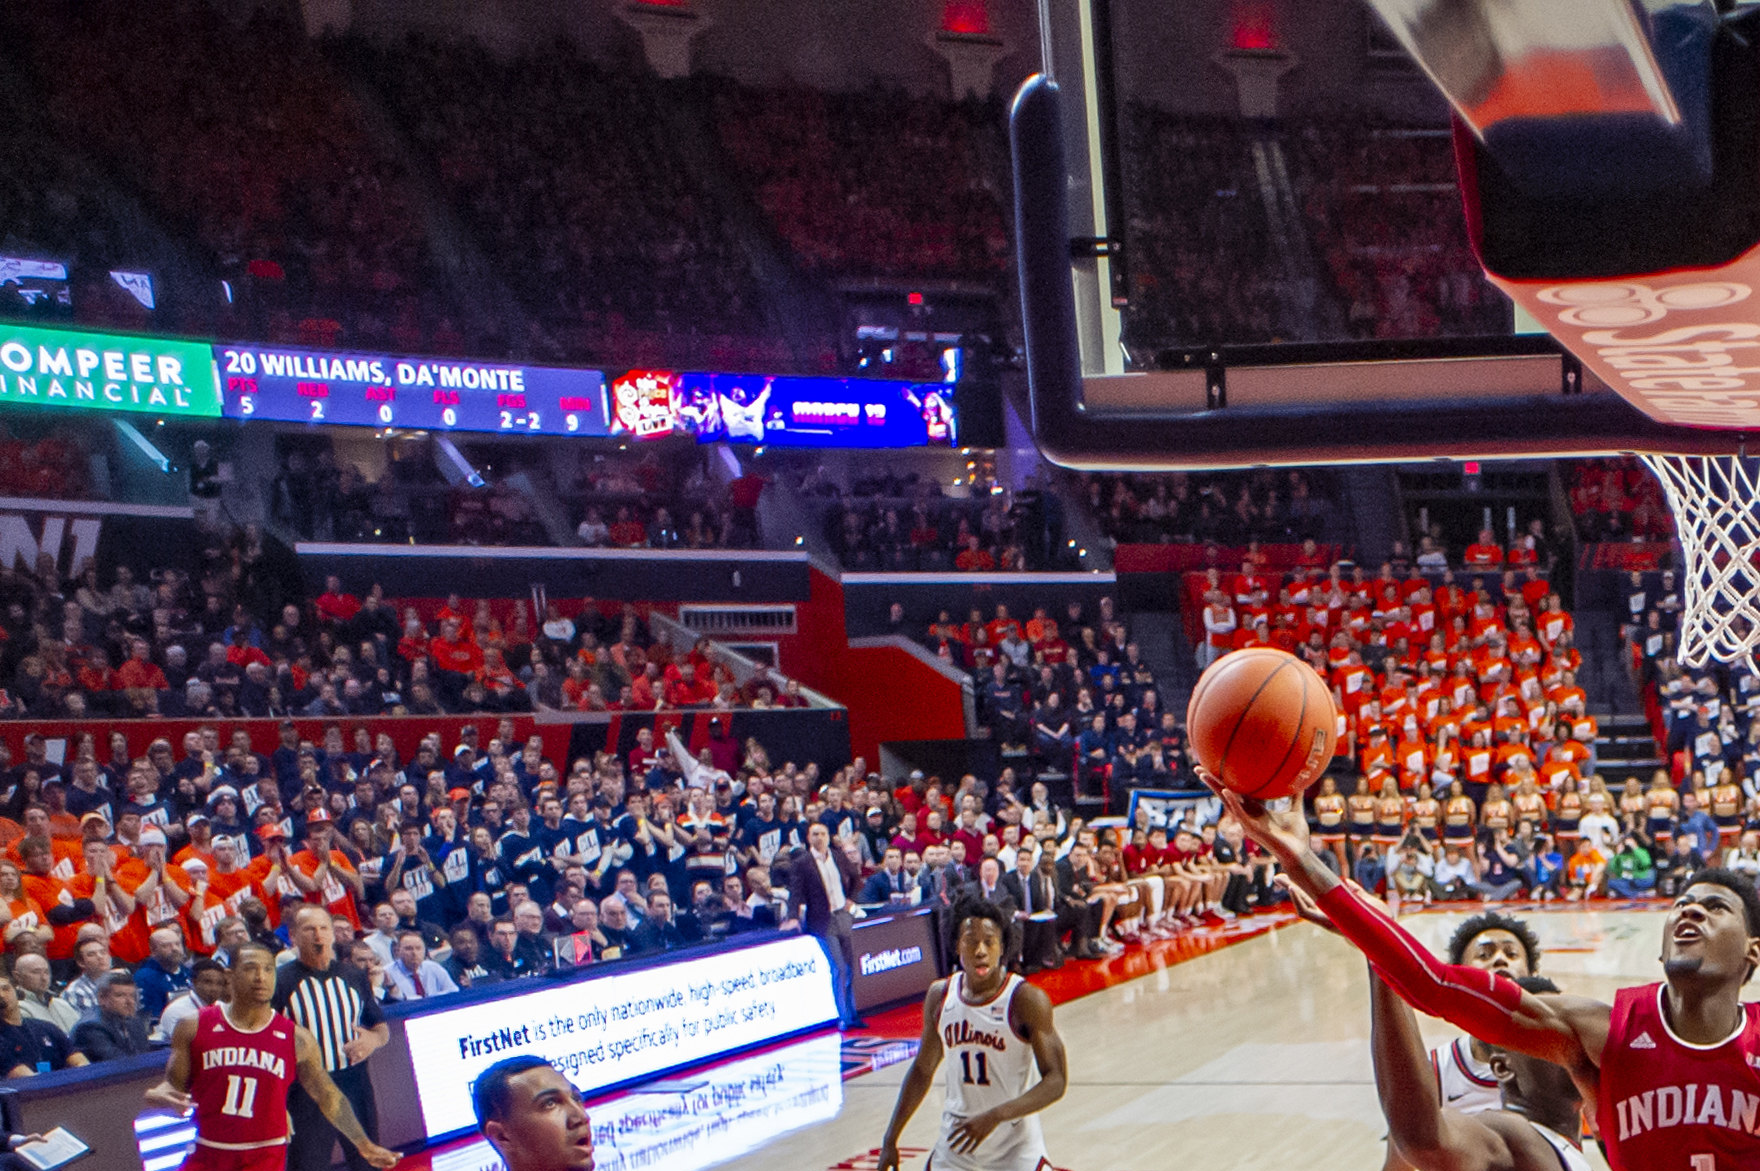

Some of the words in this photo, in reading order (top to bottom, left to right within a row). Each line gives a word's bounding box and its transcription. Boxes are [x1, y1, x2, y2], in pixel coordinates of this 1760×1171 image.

[224, 350, 256, 375] 20
[260, 353, 392, 387] WILLIAMS,
[397, 362, 525, 392] DA'MONTE
[240, 396, 255, 415] 5
[310, 400, 325, 419] 2
[378, 405, 393, 424] 0
[442, 407, 457, 427] 0
[500, 411, 542, 431] 2-2
[565, 413, 580, 433] 9
[860, 945, 922, 976] FirstNet.com
[459, 1023, 531, 1060] FirstNet
[549, 1013, 575, 1036] the
[577, 1003, 608, 1032] only
[541, 1043, 605, 1076] esigned
[608, 1023, 680, 1061] specifically
[944, 1019, 1006, 1051] Illinois
[203, 1047, 285, 1080] INDIANA
[960, 1050, 990, 1086] 11
[221, 1074, 257, 1119] 11
